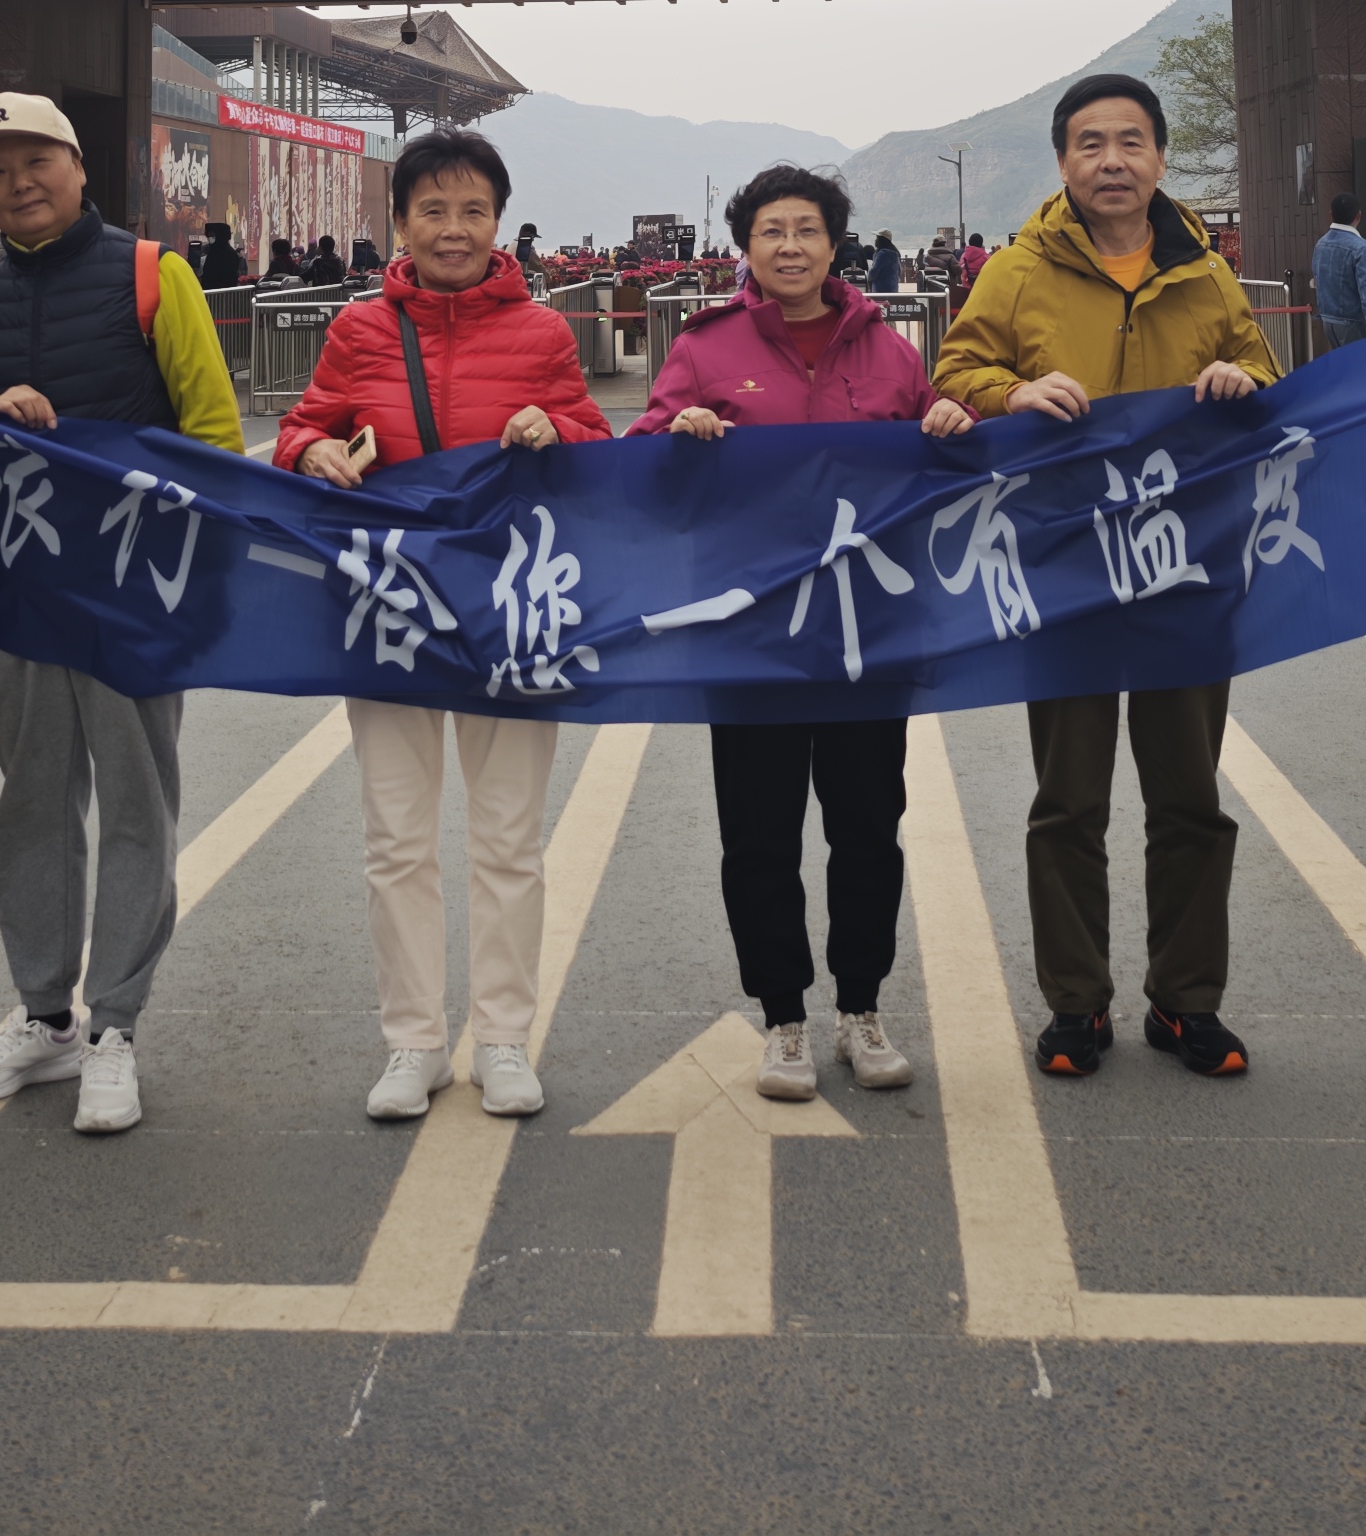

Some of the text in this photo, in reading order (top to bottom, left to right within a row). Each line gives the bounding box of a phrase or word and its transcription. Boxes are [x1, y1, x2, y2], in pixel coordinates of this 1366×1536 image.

[677, 227, 694, 236] 出口
[889, 304, 922, 313] 请勿翻越
